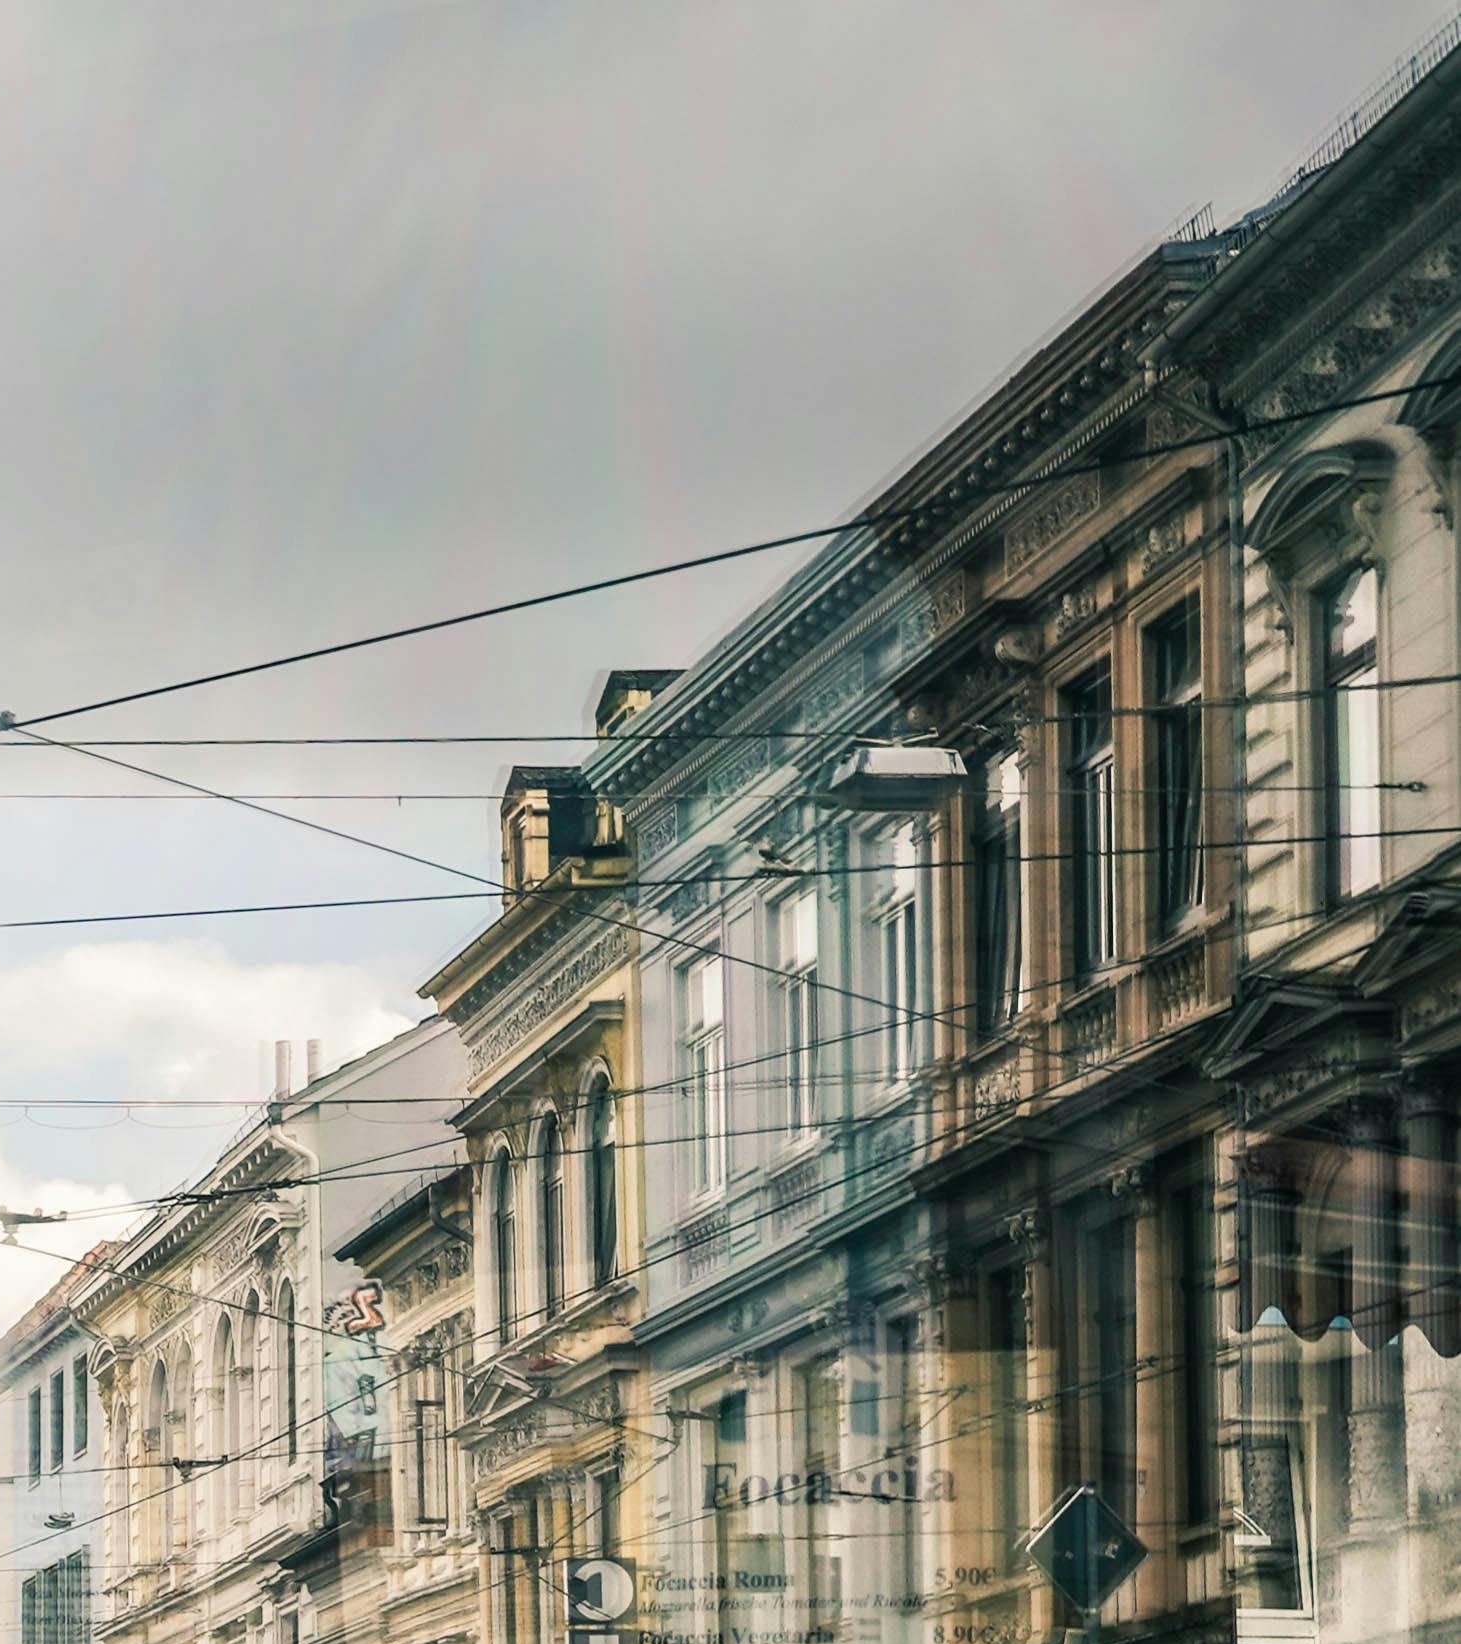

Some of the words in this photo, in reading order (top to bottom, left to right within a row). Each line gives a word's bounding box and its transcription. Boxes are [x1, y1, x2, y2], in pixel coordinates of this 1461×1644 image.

[702, 1456, 958, 1510] Focaccia
[640, 1571, 727, 1592] Focaccia
[735, 1571, 795, 1589] Roma
